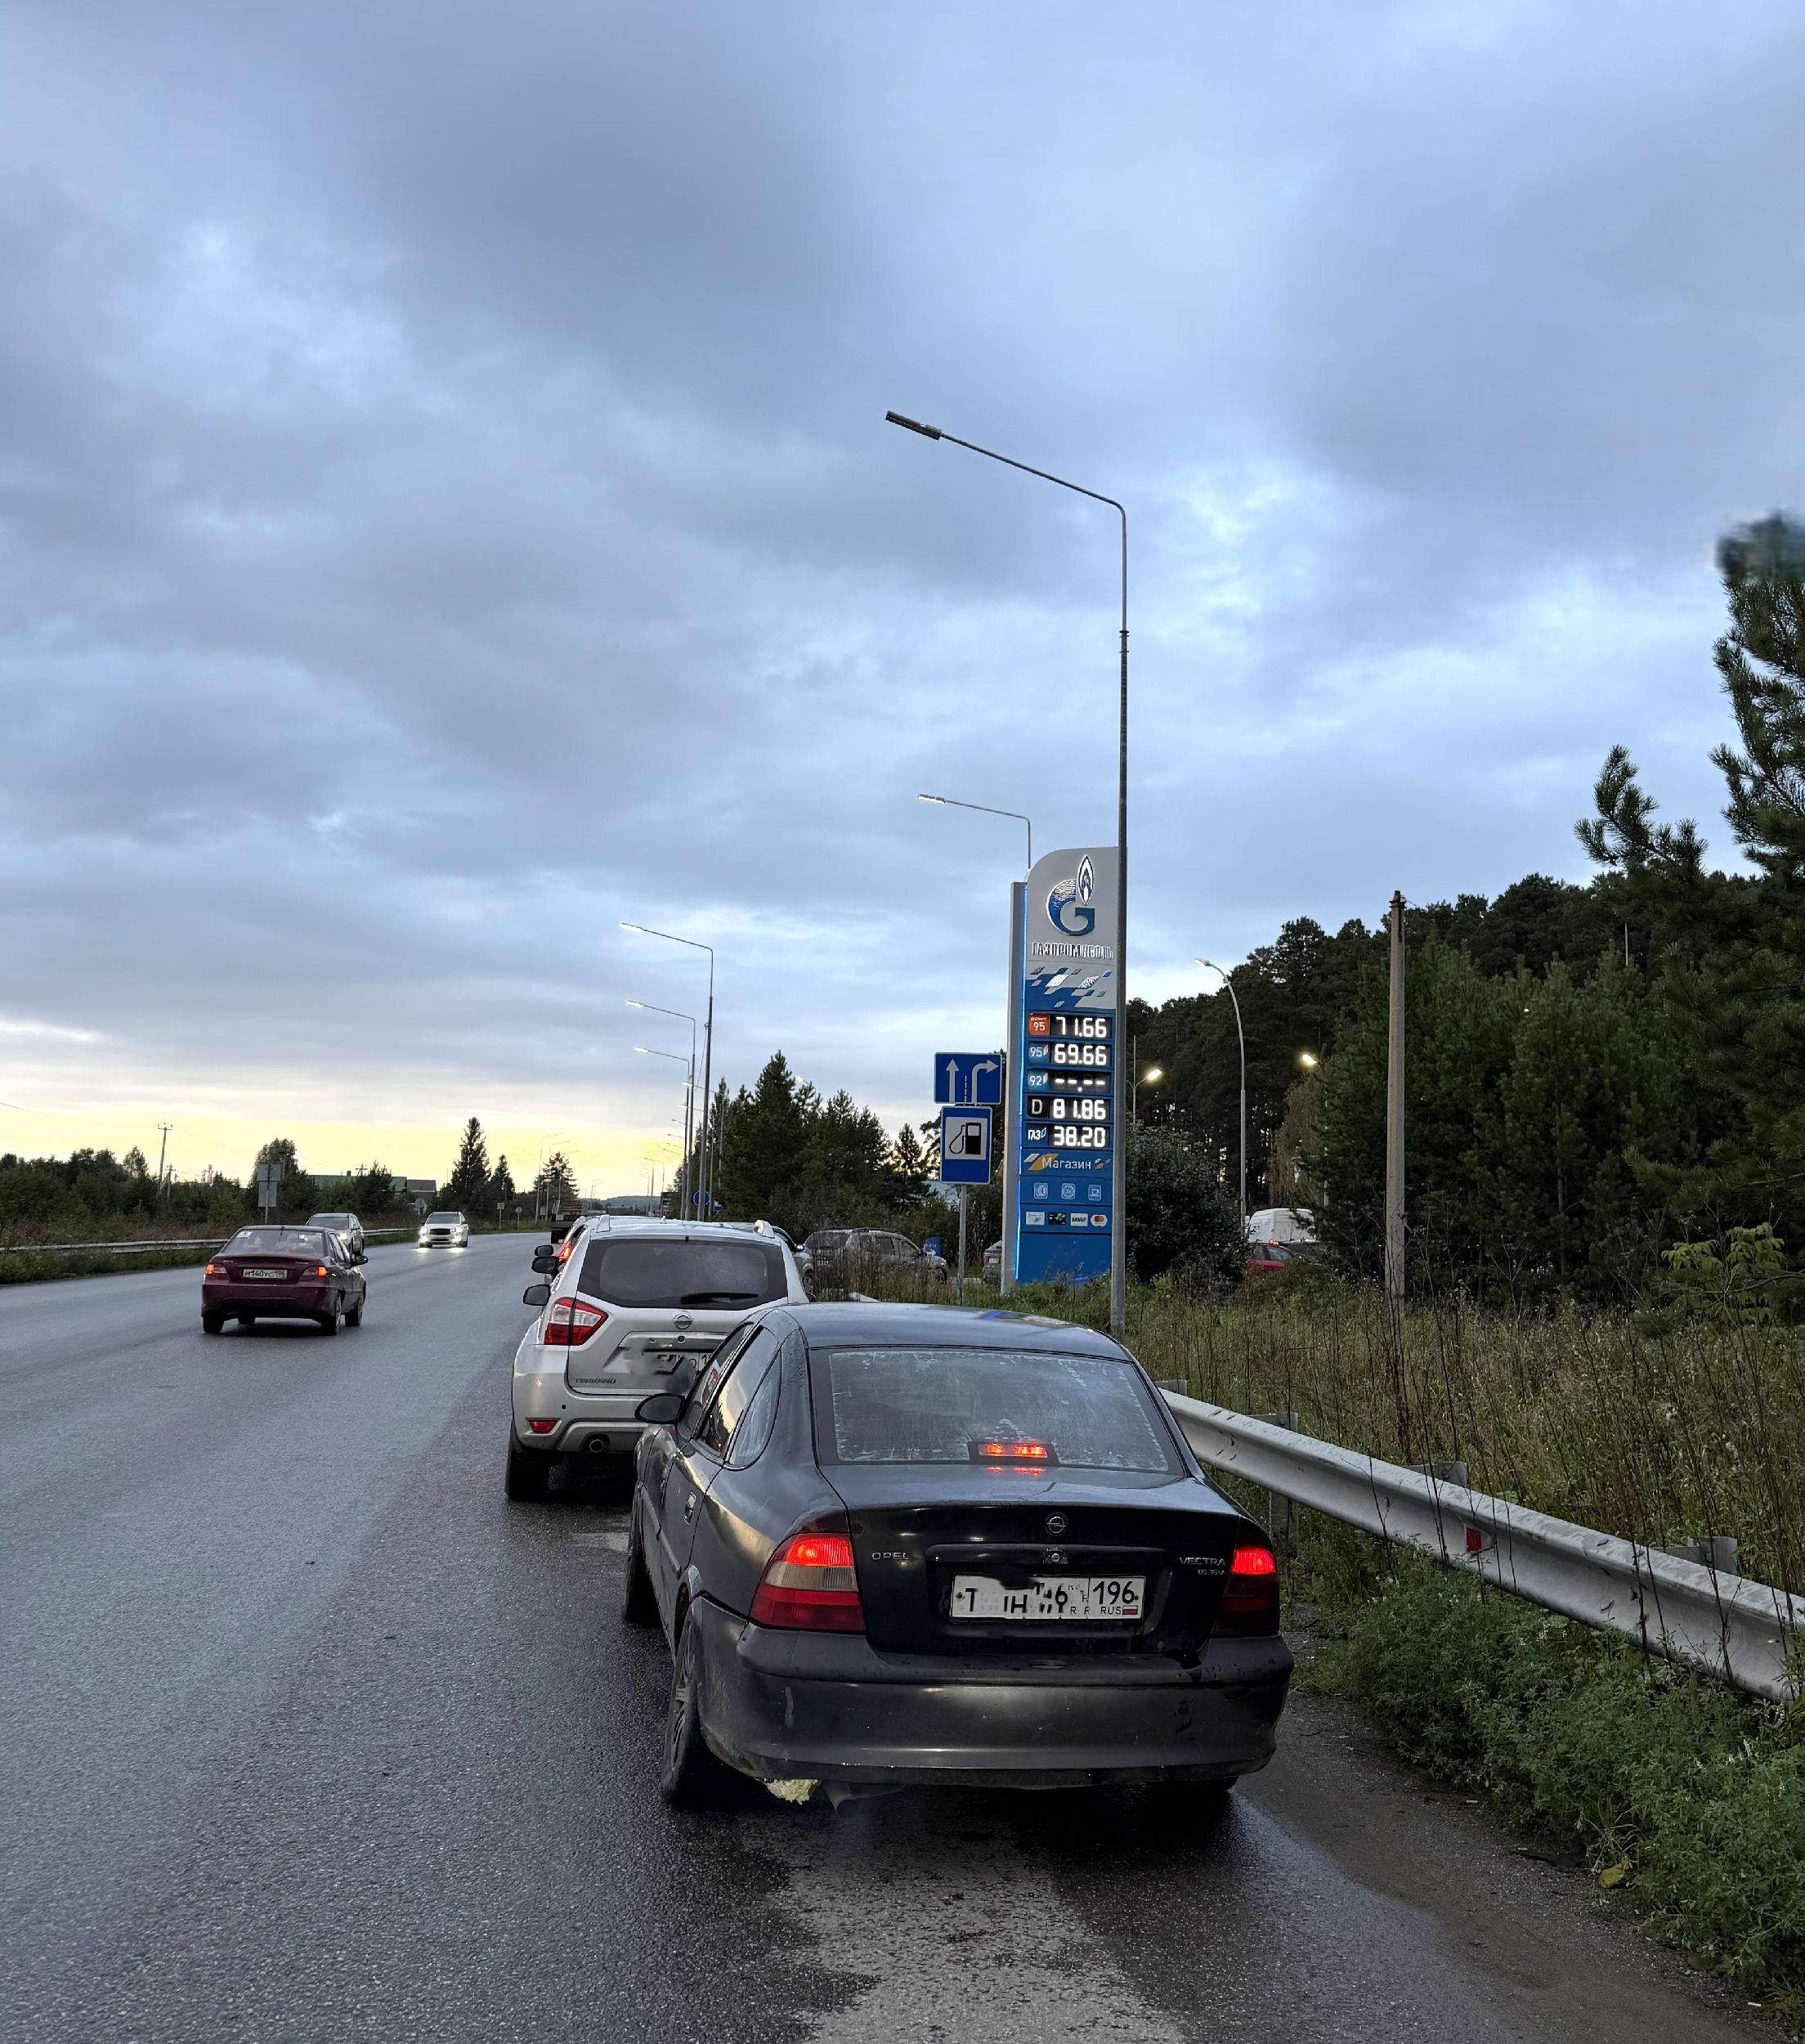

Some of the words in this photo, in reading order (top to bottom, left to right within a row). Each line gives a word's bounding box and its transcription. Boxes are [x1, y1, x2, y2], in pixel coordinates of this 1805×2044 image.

[1033, 1021, 1046, 1031] 95
[1055, 1016, 1107, 1038] 71.66
[1030, 1047, 1042, 1057] 95
[1054, 1043, 1107, 1065] 69.66
[1030, 1075, 1042, 1086] 92
[1032, 1098, 1043, 1114] D
[1053, 1098, 1106, 1119] 81.86
[1028, 1129, 1041, 1141] ГАЗ
[1054, 1125, 1106, 1147] 38.20
[1042, 1157, 1091, 1170] Магазин
[871, 1552, 911, 1560] OPEL
[1178, 1557, 1226, 1566] VECTRA
[1092, 1580, 1135, 1605] 196
[1100, 1606, 1122, 1616] RUS
